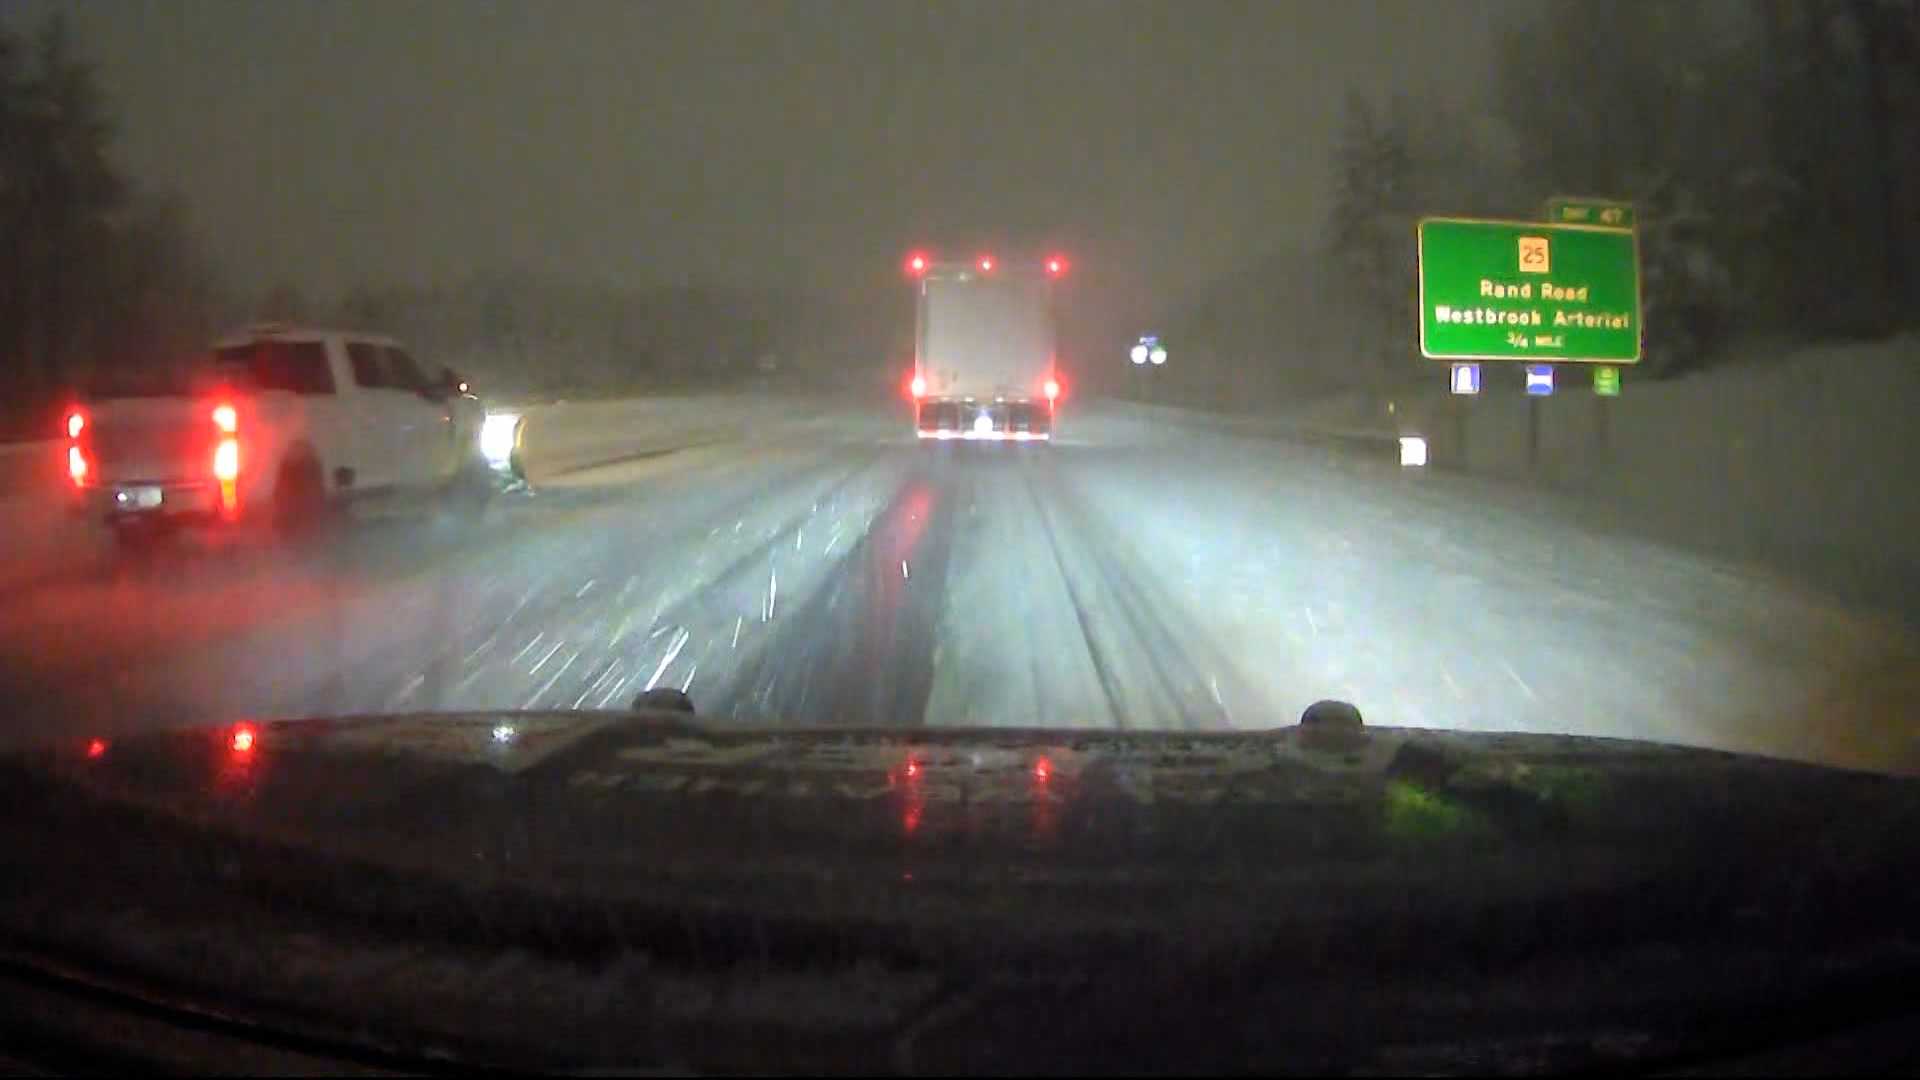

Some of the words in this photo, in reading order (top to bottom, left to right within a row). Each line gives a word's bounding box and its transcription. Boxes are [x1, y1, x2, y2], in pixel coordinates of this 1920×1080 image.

[1522, 244, 1545, 264] 25
[1480, 279, 1531, 299] Rand
[1541, 282, 1589, 303] Road
[1434, 304, 1542, 326] Westbrook
[1553, 309, 1630, 329] Arterial
